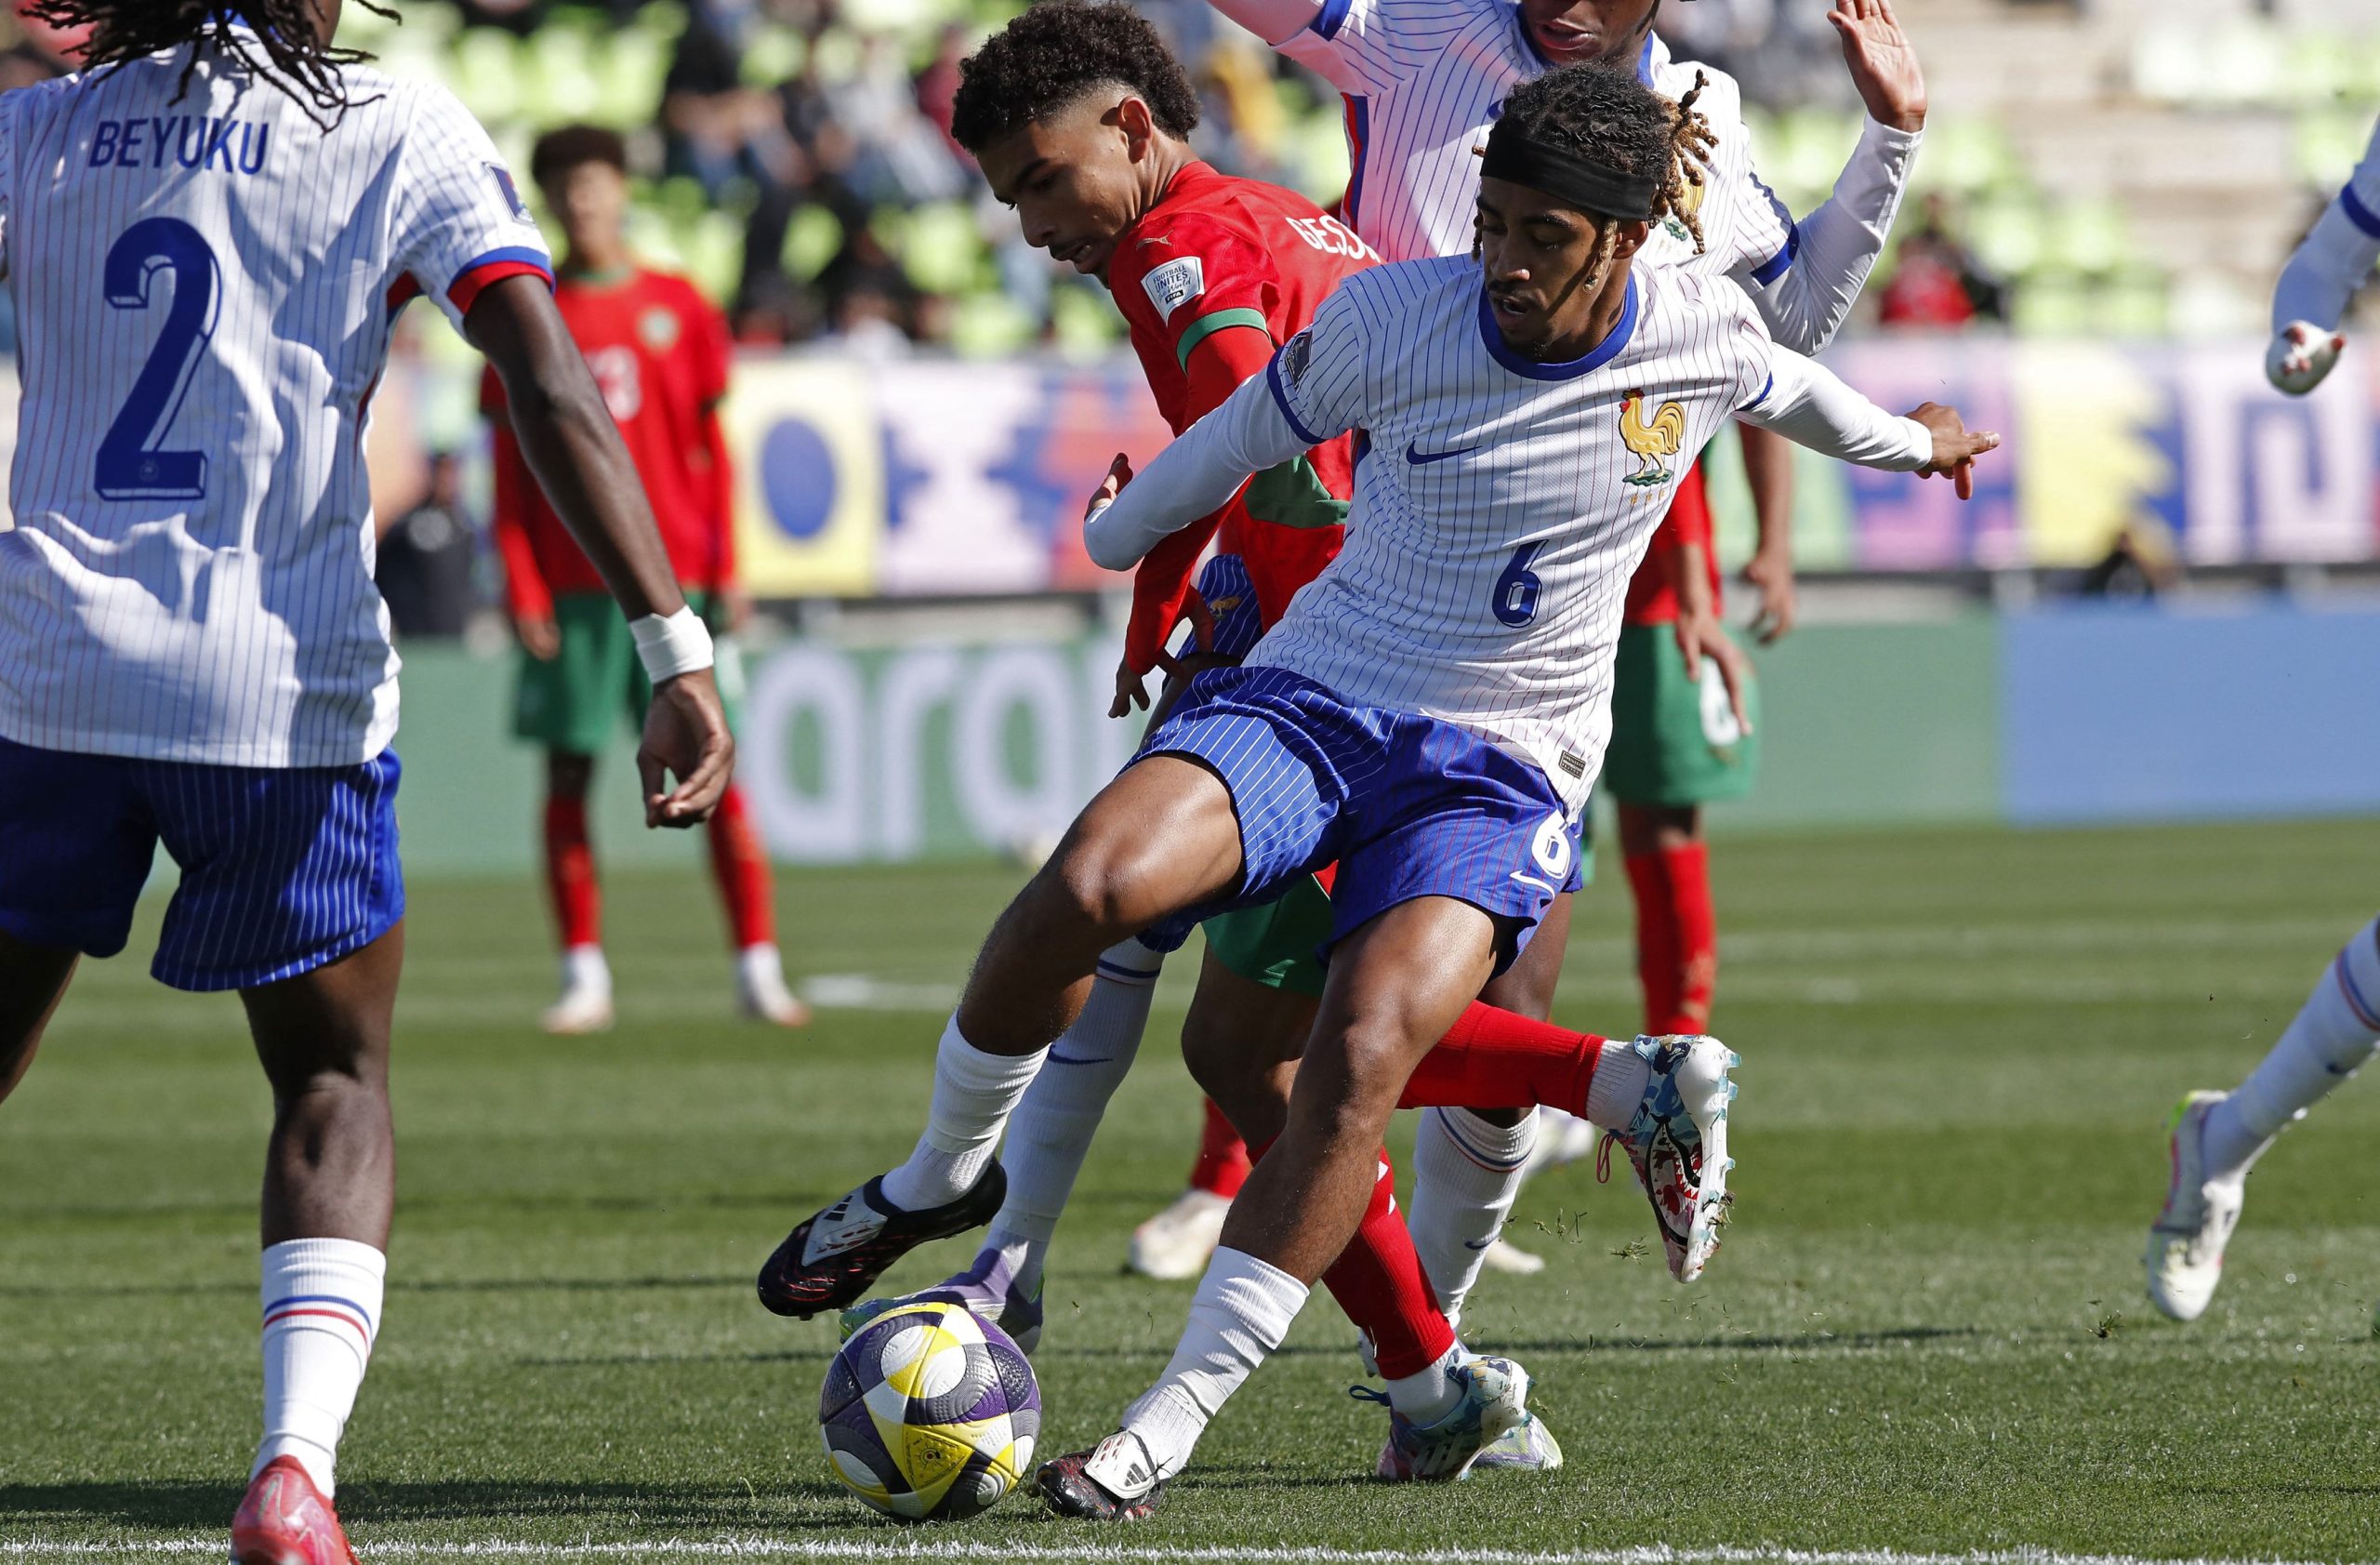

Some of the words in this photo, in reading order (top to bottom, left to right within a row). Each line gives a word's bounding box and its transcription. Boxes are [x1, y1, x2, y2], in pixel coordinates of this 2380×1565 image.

[88, 116, 269, 175] BEYUKU
[1285, 215, 1382, 263] GESS
[1153, 264, 1187, 283] FOOTBALL
[1155, 270, 1188, 293] UNITES
[1166, 291, 1183, 303] FIFA
[94, 217, 222, 501] 2
[1491, 538, 1550, 629] 6
[1531, 807, 1571, 879] 6
